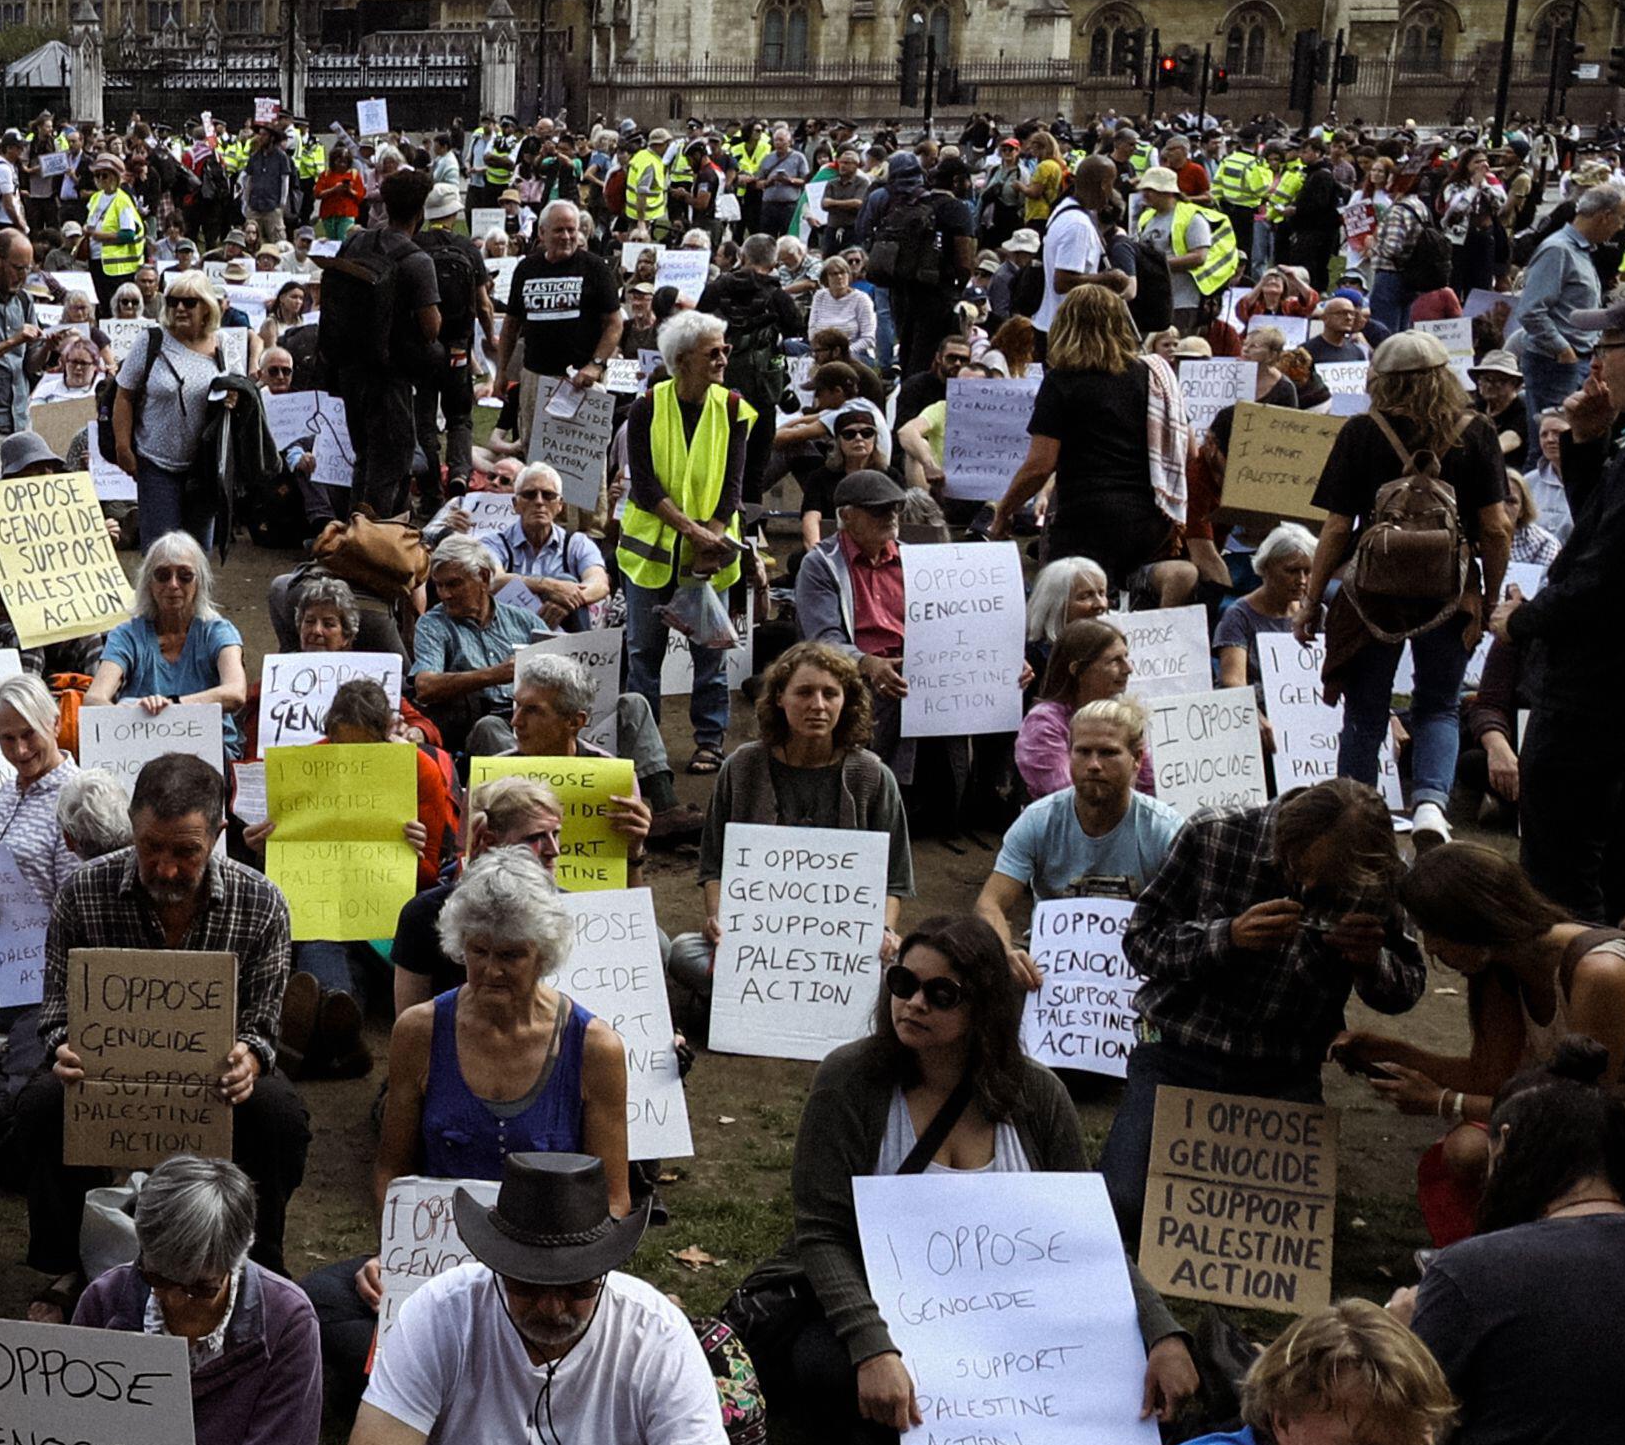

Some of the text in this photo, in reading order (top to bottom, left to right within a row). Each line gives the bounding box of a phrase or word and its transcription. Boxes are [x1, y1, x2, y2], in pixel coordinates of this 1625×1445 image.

[524, 278, 583, 293] PLASTICINE
[1181, 381, 1245, 398] GENOCIDE
[550, 426, 608, 445] SUPPORT
[4, 477, 84, 512] OPPOSE
[24, 528, 113, 568] SUPPORT
[3, 559, 126, 598] PALESTINE
[914, 566, 1006, 592] OPPOSE
[43, 590, 122, 630] ACTION
[909, 596, 1005, 623] GENOCIDE
[912, 649, 1000, 666] SUPPORT
[909, 668, 1012, 690] PALESTINE
[925, 693, 995, 714] ACTION
[114, 720, 203, 740] OPPOSE
[1186, 704, 1254, 739] OPPOSE
[302, 760, 373, 777] OPPOSE
[1159, 756, 1255, 788] GENOCIDE
[279, 794, 382, 812] GENOCIDE
[765, 849, 858, 870] OPPOSE
[280, 867, 400, 885] PALESTINE
[752, 915, 873, 944] SUPPORT
[736, 948, 872, 974] PALESTINE
[102, 979, 222, 1013] OPPOSE
[741, 982, 851, 1006] ACTION
[80, 1023, 207, 1055] GENOCIDE
[74, 1103, 211, 1125] PALESTINE
[1207, 1102, 1324, 1147] OPPOSE
[109, 1130, 202, 1152] ACTION
[1169, 1141, 1320, 1188] GENOCIDE
[1189, 1185, 1324, 1231] SUPPORT
[925, 1224, 1072, 1278] OPPOSE
[1158, 1217, 1323, 1270] PALESTINE
[1171, 1260, 1298, 1303] ACTION
[900, 1290, 1038, 1326] GENOCIDE
[956, 1346, 1082, 1380] SUPPORT
[916, 1394, 1061, 1423] PALESTINE
